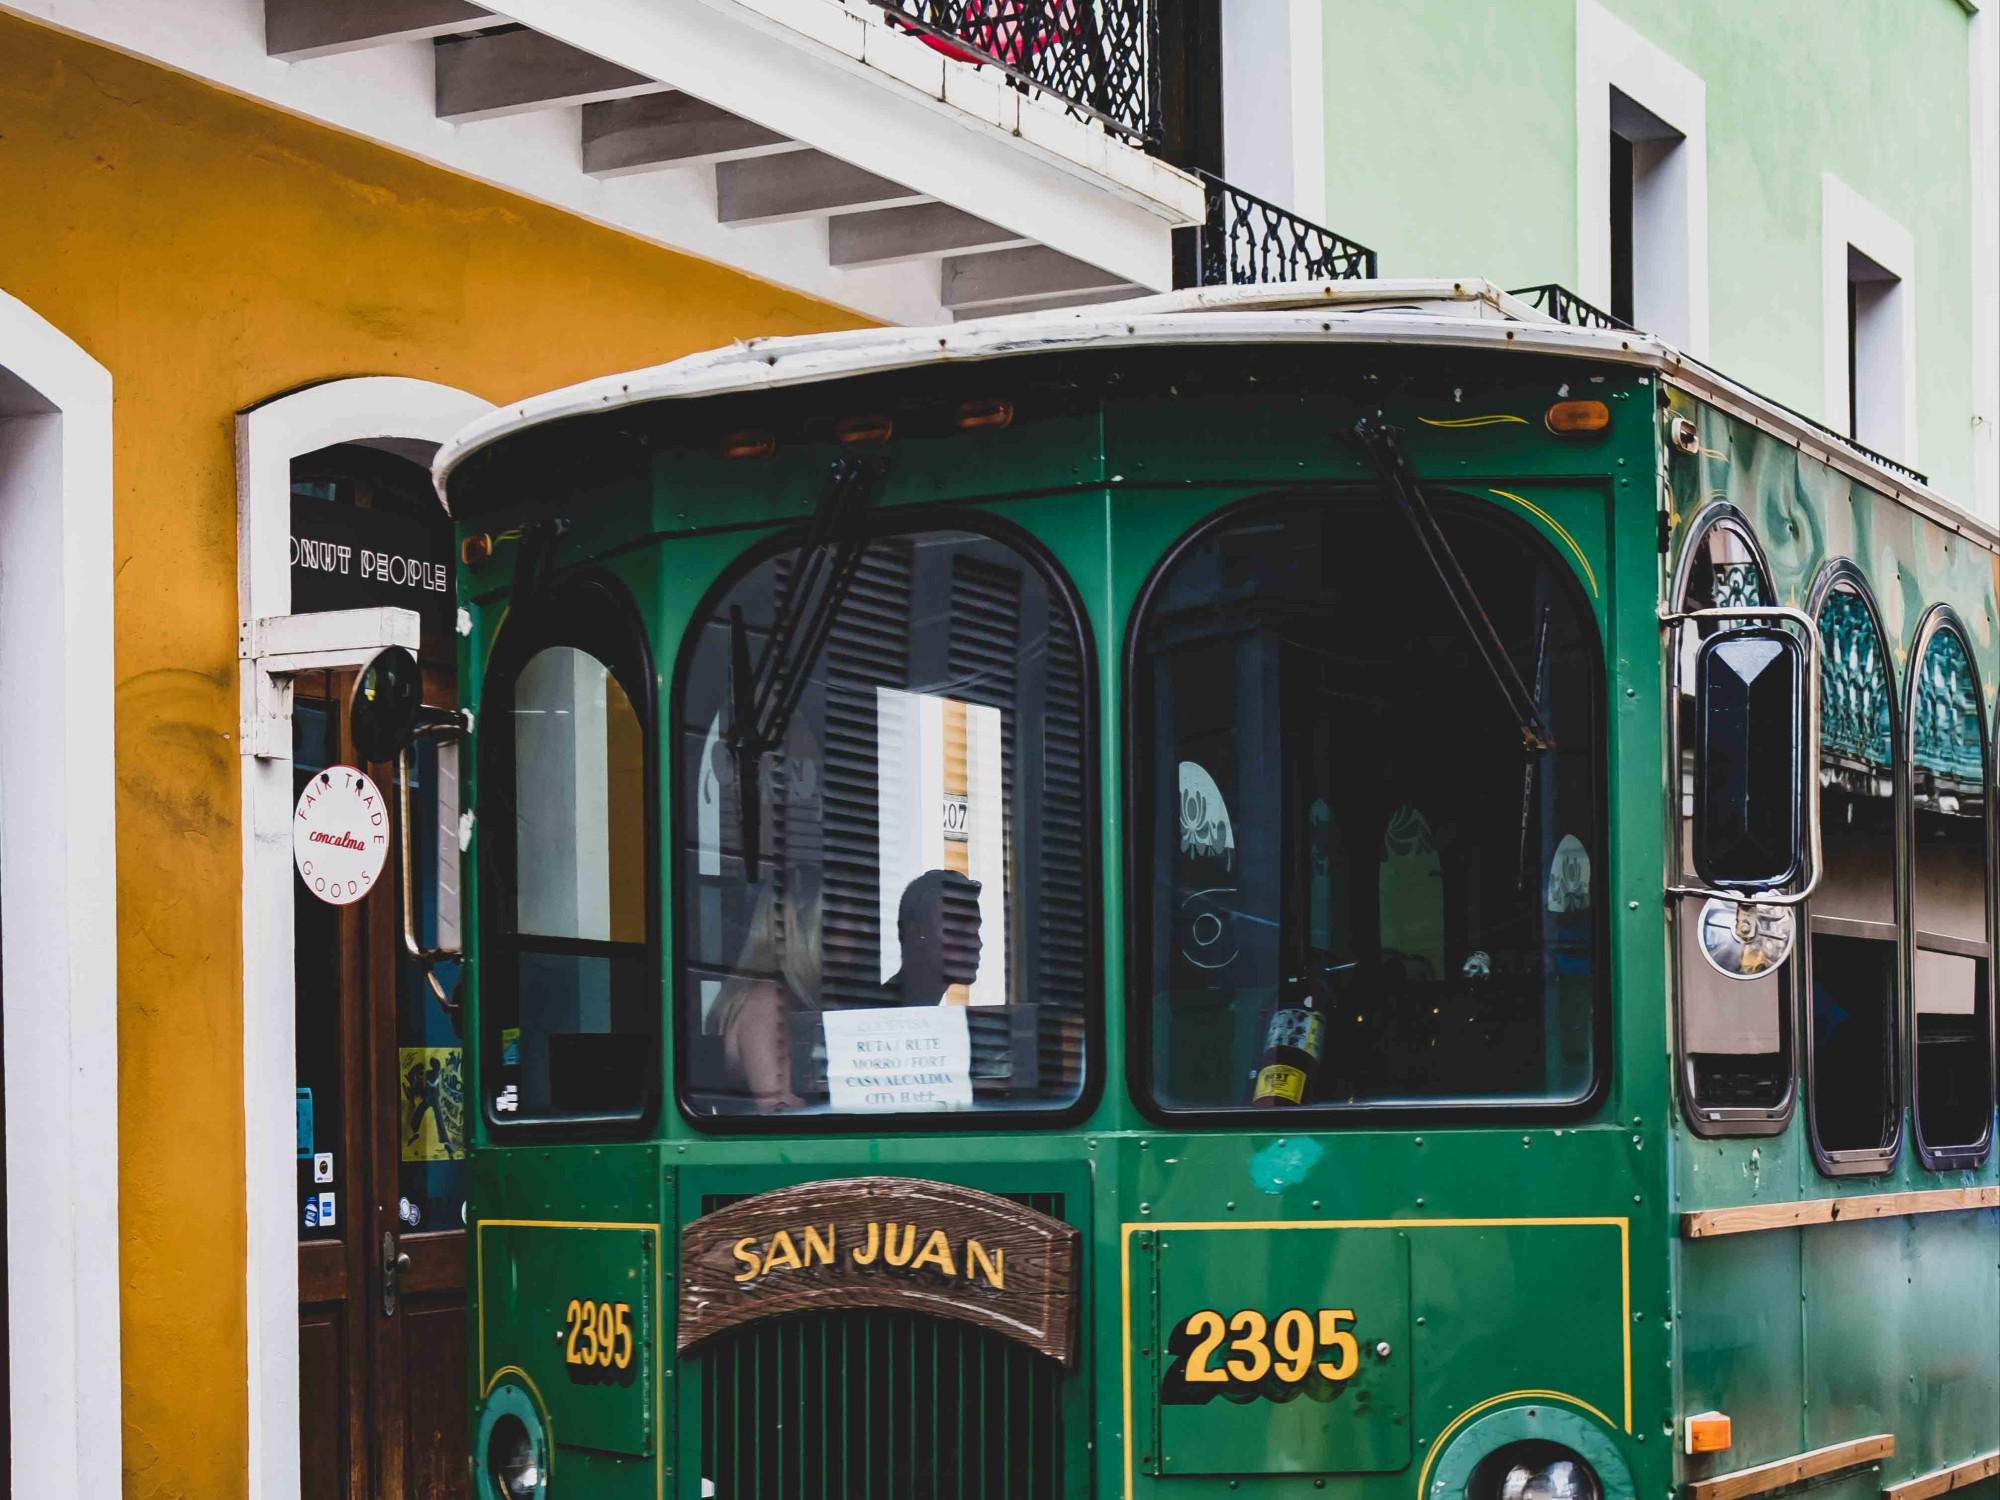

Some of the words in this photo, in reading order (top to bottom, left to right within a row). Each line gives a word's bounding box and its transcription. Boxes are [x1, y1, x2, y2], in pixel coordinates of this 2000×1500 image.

[361, 550, 447, 592] PEOPLE
[942, 803, 968, 830] 07
[308, 830, 366, 851] concalma
[302, 860, 371, 898] GOODS
[911, 1055, 948, 1068] FORT
[733, 1222, 836, 1282] SAN
[852, 1222, 1005, 1290] JUAN
[565, 1299, 633, 1369] 2395
[1184, 1309, 1360, 1383] 2395
